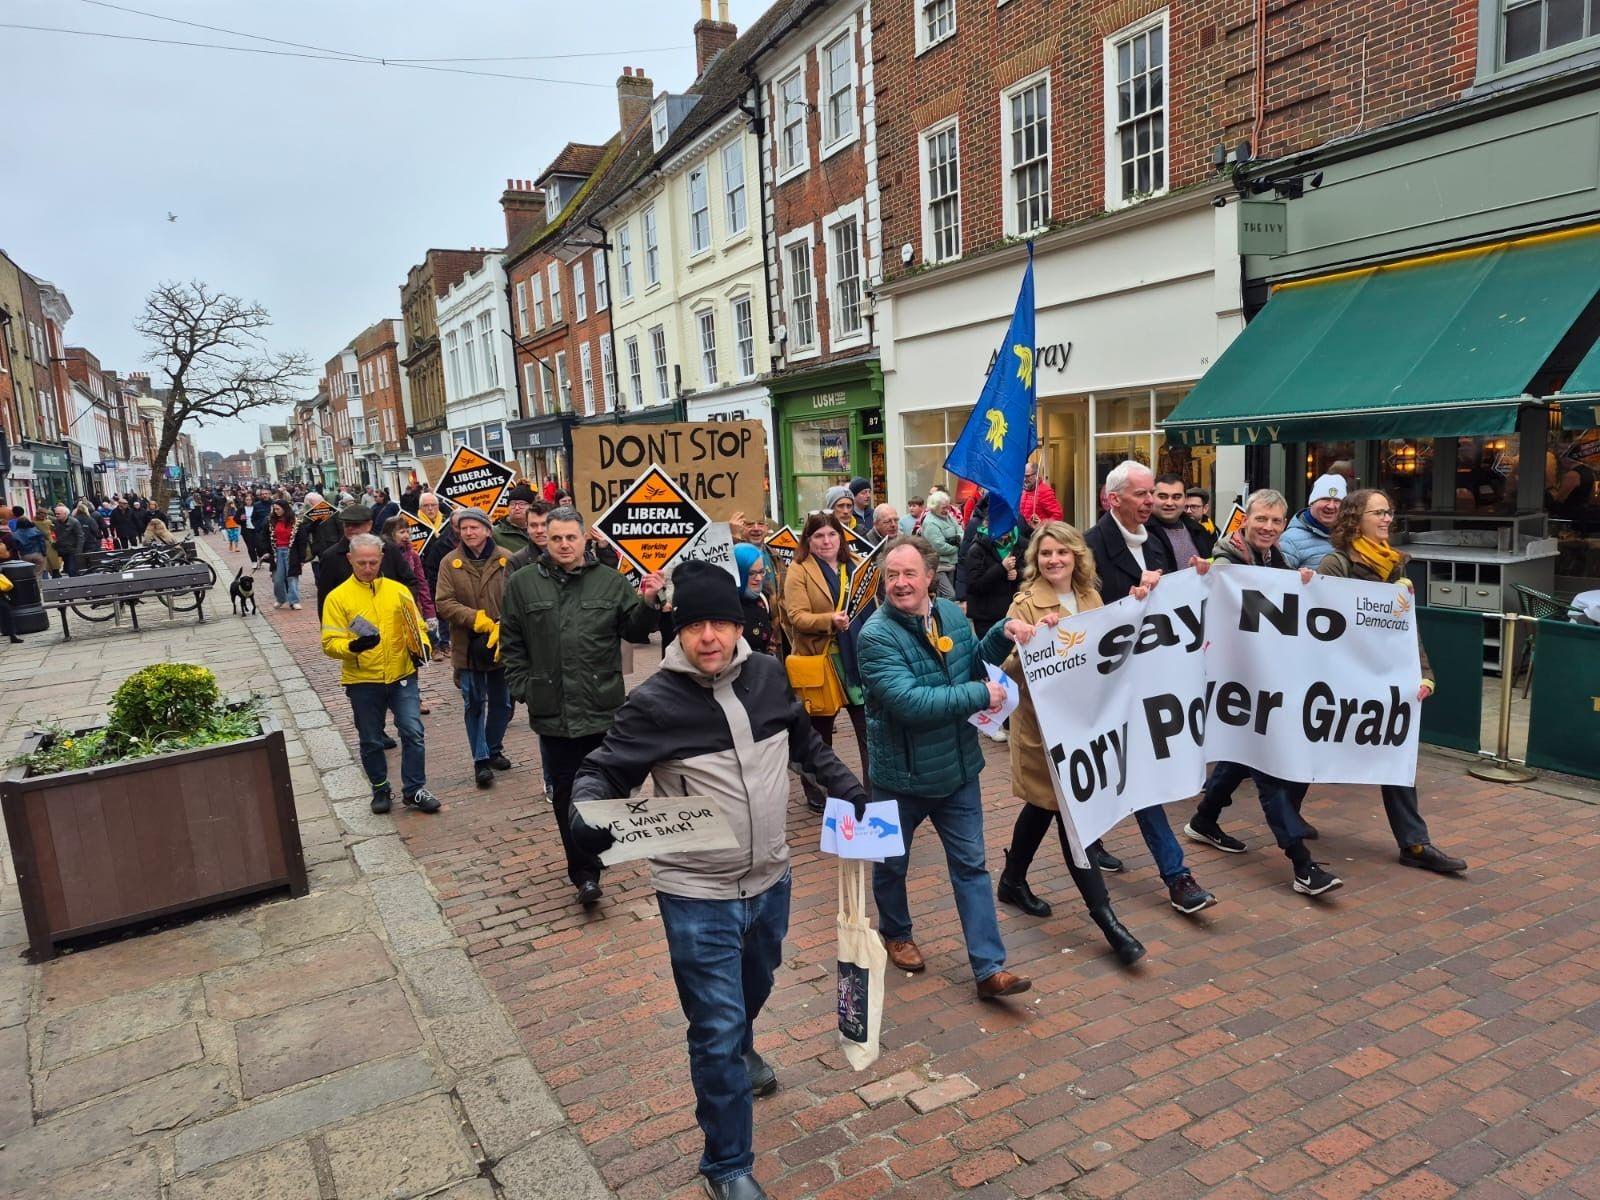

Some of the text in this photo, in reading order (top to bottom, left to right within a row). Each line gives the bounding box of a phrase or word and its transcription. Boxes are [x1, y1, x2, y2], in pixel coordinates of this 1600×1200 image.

[1243, 222, 1283, 233] THE IVY
[984, 341, 1072, 376] Aray
[812, 393, 835, 409] LUSH
[869, 416, 879, 426] 87
[1179, 425, 1281, 445] THE IVY
[598, 427, 752, 469] DON'T STOP
[445, 475, 506, 497] DEMOCRATS
[452, 468, 493, 484] LIBERAL
[590, 471, 740, 513] DERACY
[627, 507, 682, 521] LIBERAL
[612, 522, 695, 536] DEMOCRATS
[640, 542, 668, 551] Working
[654, 551, 667, 559] You
[680, 542, 730, 562] WE WANT
[704, 552, 731, 564] VOTE
[1238, 588, 1347, 642] No
[1356, 596, 1394, 614] Liberal
[1355, 612, 1410, 632] Democrats
[1024, 639, 1056, 668] beral
[1026, 652, 1087, 683] emocrats
[1302, 681, 1412, 747] Grab
[629, 812, 668, 827] WANT
[678, 808, 714, 821] OUR
[613, 821, 695, 844] VOTE BACK!
